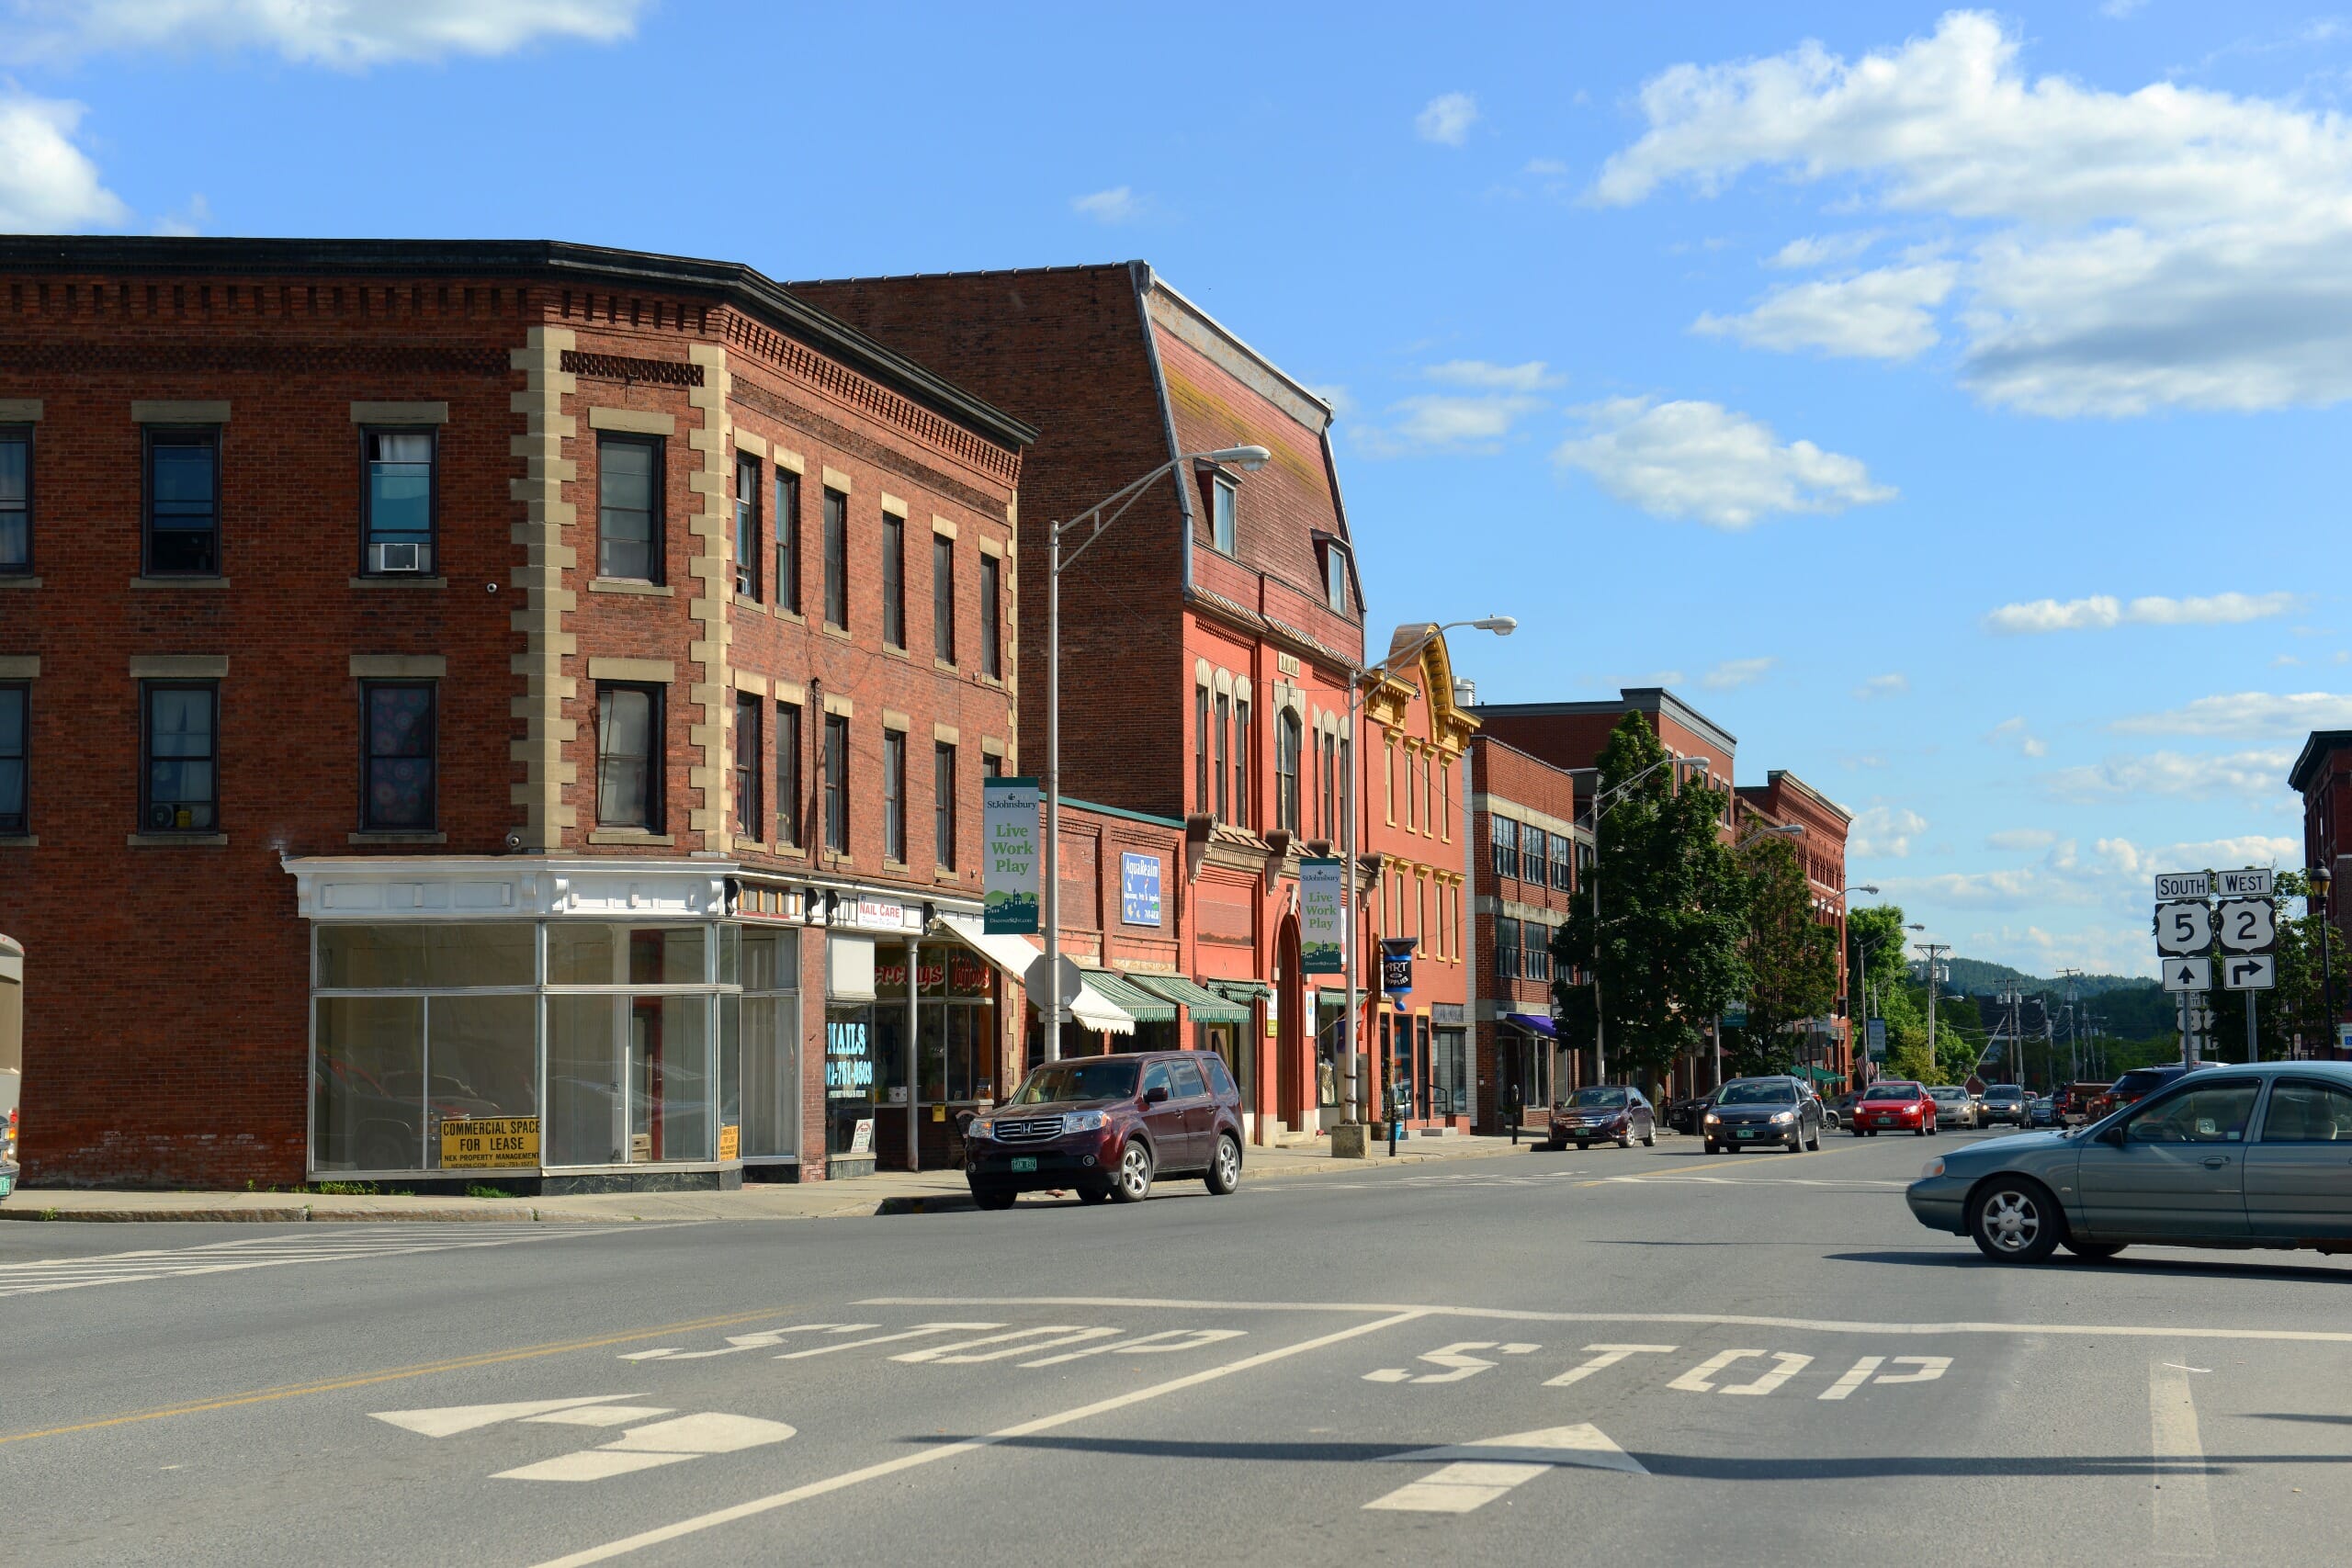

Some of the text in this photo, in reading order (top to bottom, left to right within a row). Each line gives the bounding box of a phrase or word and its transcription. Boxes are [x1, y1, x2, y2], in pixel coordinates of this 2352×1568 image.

[995, 823, 1029, 838] Live
[991, 840, 1034, 855] Work
[995, 858, 1030, 876] Play
[1308, 892, 1333, 903] Live
[1306, 905, 1337, 916] Work
[1308, 917, 1334, 931] Play
[2175, 913, 2195, 942] 5
[2236, 910, 2257, 941] 2
[1385, 961, 1408, 973] ART
[827, 1022, 866, 1055] NAILS
[443, 1121, 540, 1136] COMMERCIAL SPACE
[460, 1137, 525, 1152] FOR LEASE
[496, 1152, 539, 1160] MANAGEMENT
[616, 1322, 1249, 1369] STOP
[1363, 1341, 1955, 1401] STOP
